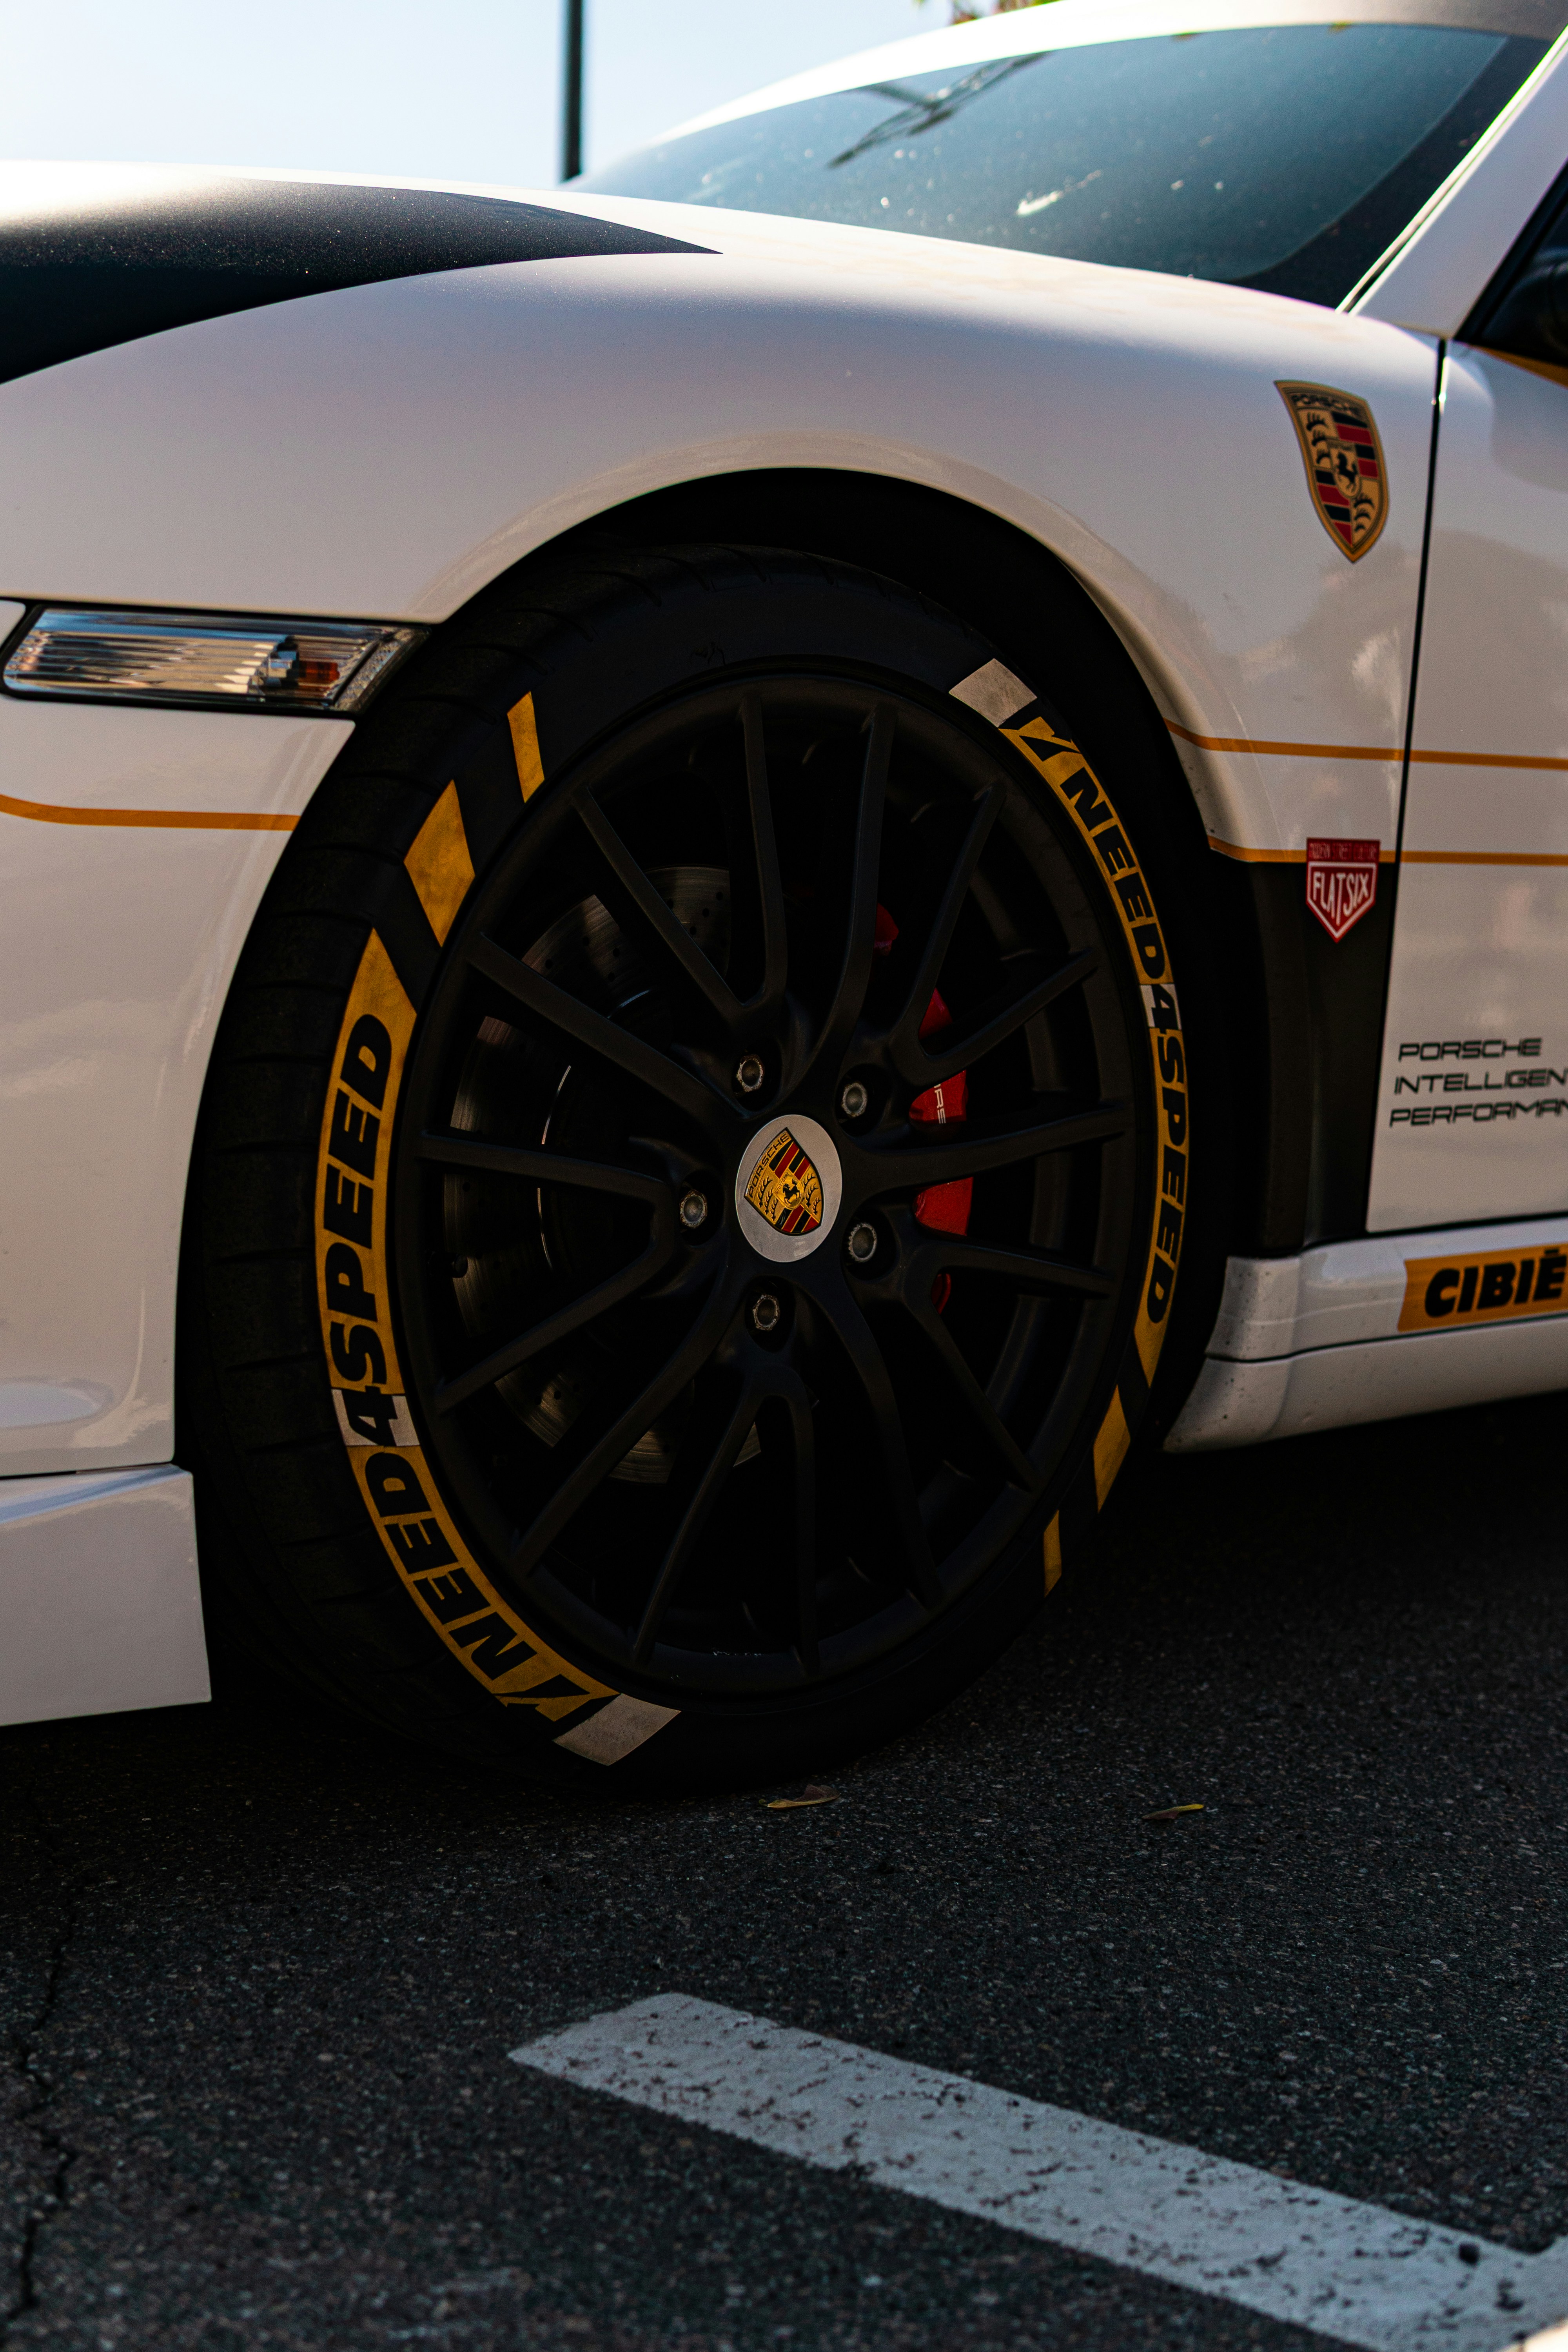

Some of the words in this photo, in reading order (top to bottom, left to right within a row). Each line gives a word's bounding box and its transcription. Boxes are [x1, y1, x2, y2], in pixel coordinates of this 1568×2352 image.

[1060, 767, 1187, 1324] NEED4SPEED
[1398, 1037, 1543, 1062] PORSCHE
[748, 1133, 790, 1198] PORSCHE
[775, 1171, 790, 1194] STUTTGART
[323, 1014, 538, 1681] NEED4SPEED
